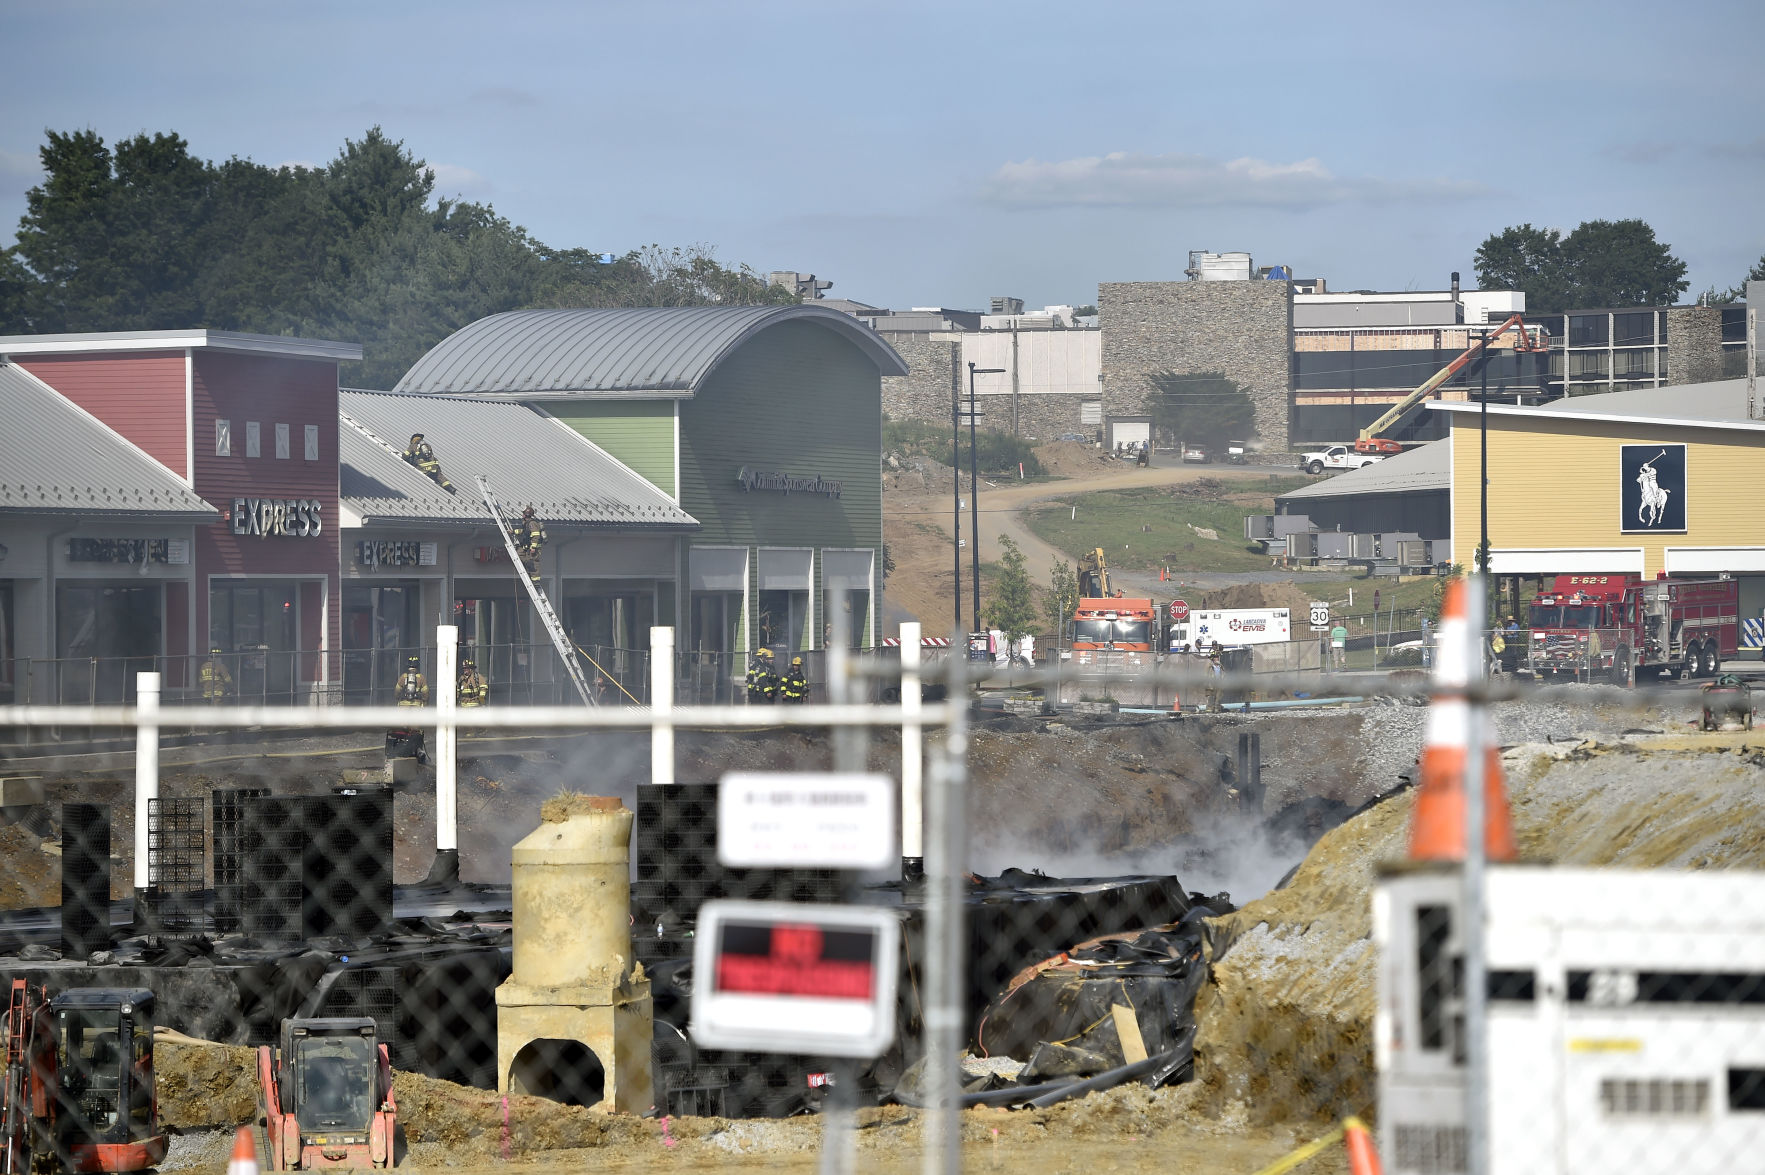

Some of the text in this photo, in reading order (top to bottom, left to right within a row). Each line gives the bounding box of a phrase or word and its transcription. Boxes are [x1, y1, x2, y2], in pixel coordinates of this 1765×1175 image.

[232, 497, 322, 539] EXPRESS
[1570, 576, 1608, 585] E-62-2
[1170, 606, 1187, 614] STOP
[1312, 611, 1327, 621] 30
